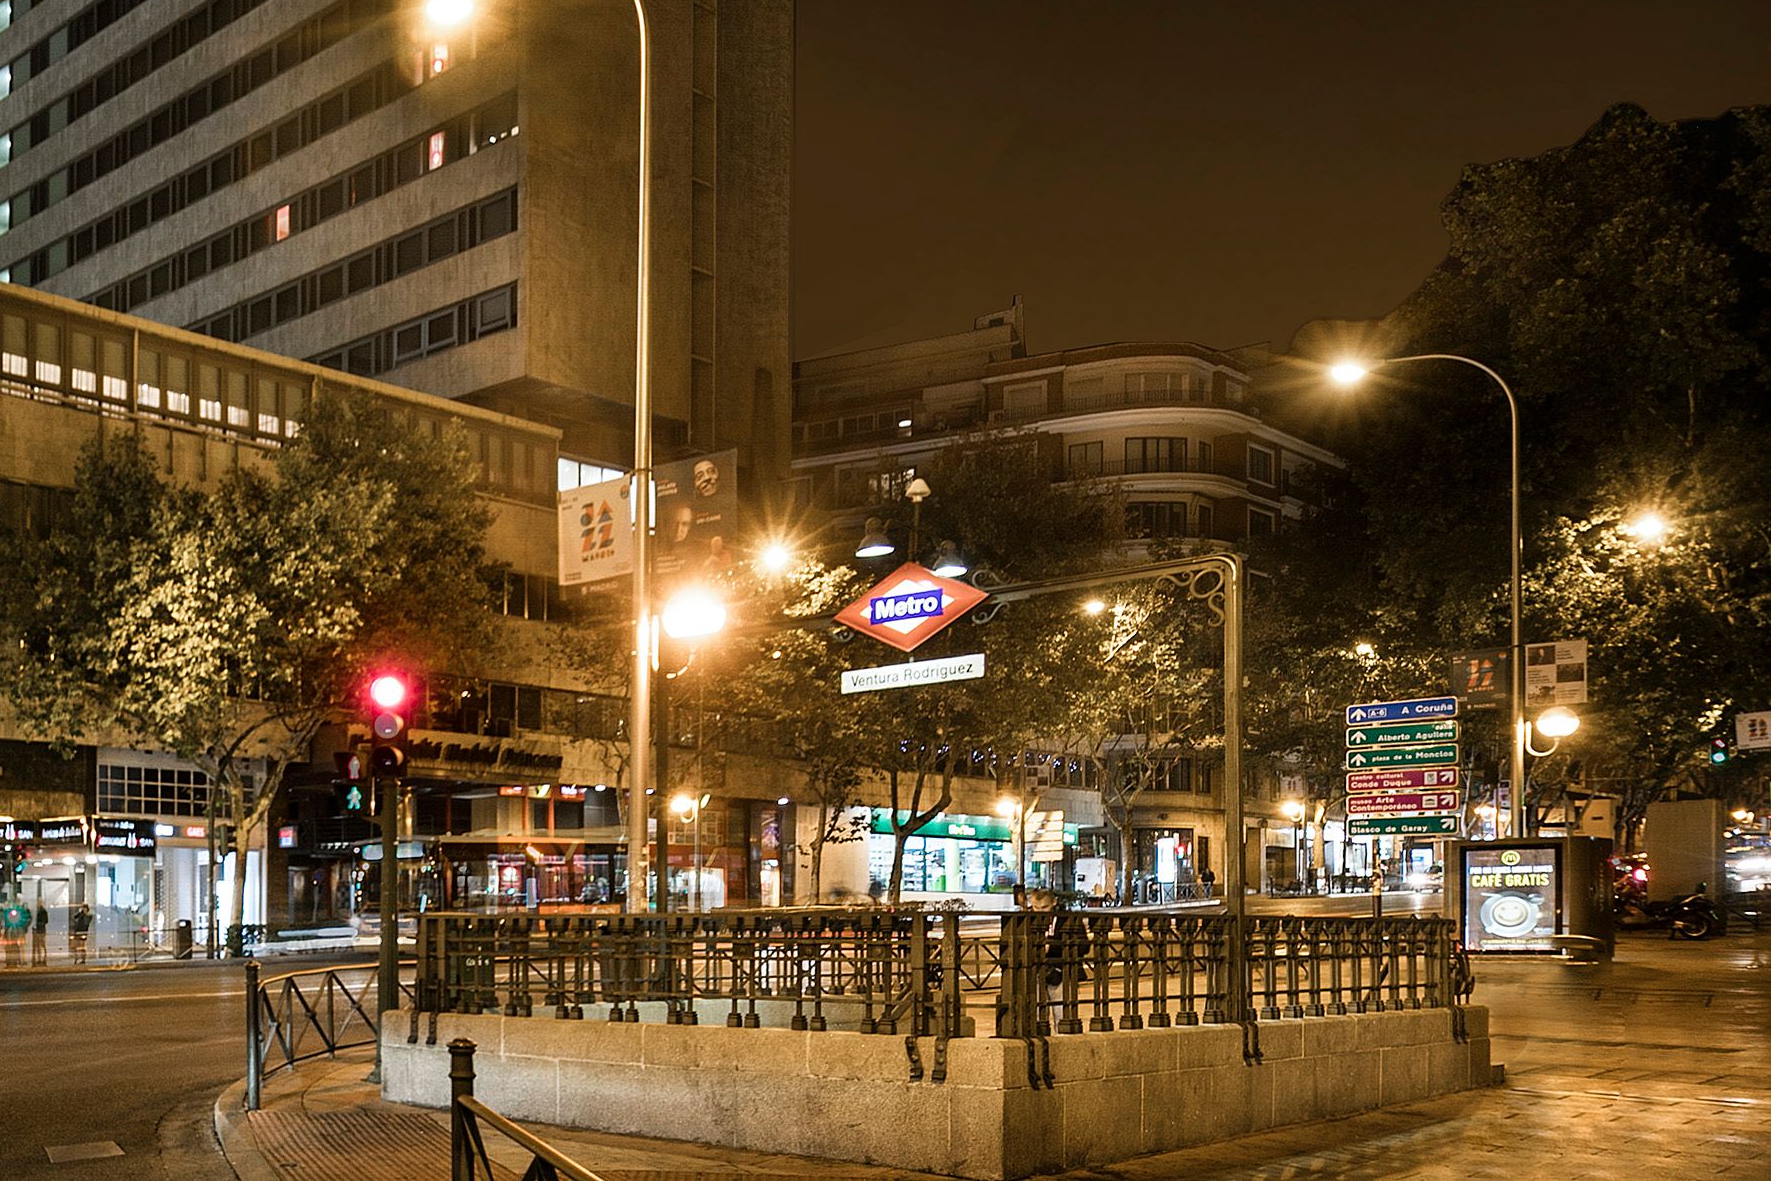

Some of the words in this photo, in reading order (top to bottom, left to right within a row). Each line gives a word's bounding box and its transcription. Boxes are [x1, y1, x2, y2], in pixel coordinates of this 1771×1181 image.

[875, 596, 938, 620] Metro
[851, 673, 899, 687] Ventura
[1401, 706, 1409, 715] A
[1415, 703, 1454, 713] Coruña
[1377, 733, 1410, 742] Alberto
[1415, 730, 1453, 740] Aguilera
[1415, 750, 1454, 759] Moncloa
[1351, 780, 1379, 788] Conde
[1383, 779, 1412, 788] Duque
[1375, 796, 1395, 804] Arte
[1350, 802, 1418, 812] Contemporáneo
[1350, 826, 1381, 834] Blasco
[1385, 825, 1397, 833] de
[1401, 824, 1428, 833] Garay
[1471, 873, 1502, 888] CAFÉ
[1505, 873, 1550, 888] GRATIS
